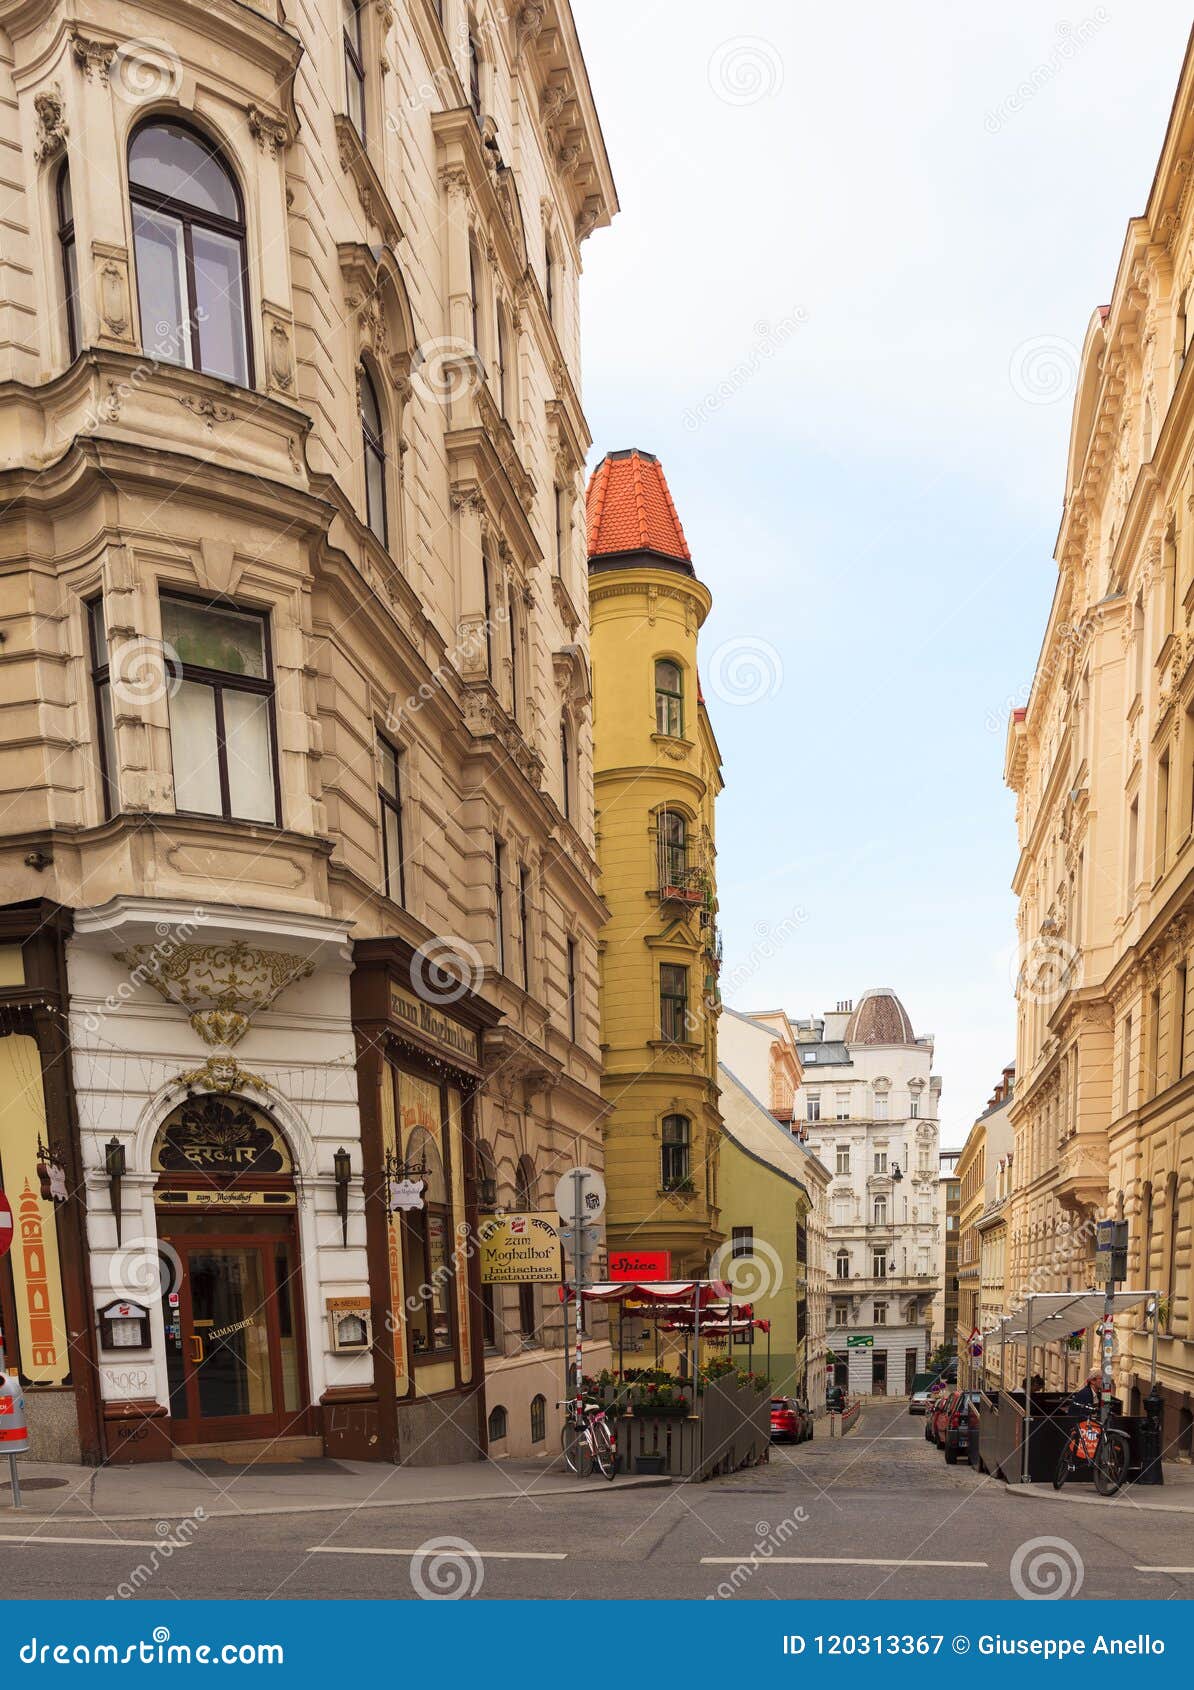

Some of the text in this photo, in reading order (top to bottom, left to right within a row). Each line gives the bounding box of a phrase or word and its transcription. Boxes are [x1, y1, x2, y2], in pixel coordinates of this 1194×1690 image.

[489, 1266, 553, 1274] Indisches
[611, 1258, 657, 1272] Spice
[484, 1273, 561, 1281] Restaurant
[208, 1318, 255, 1341] KLIMATISIERT
